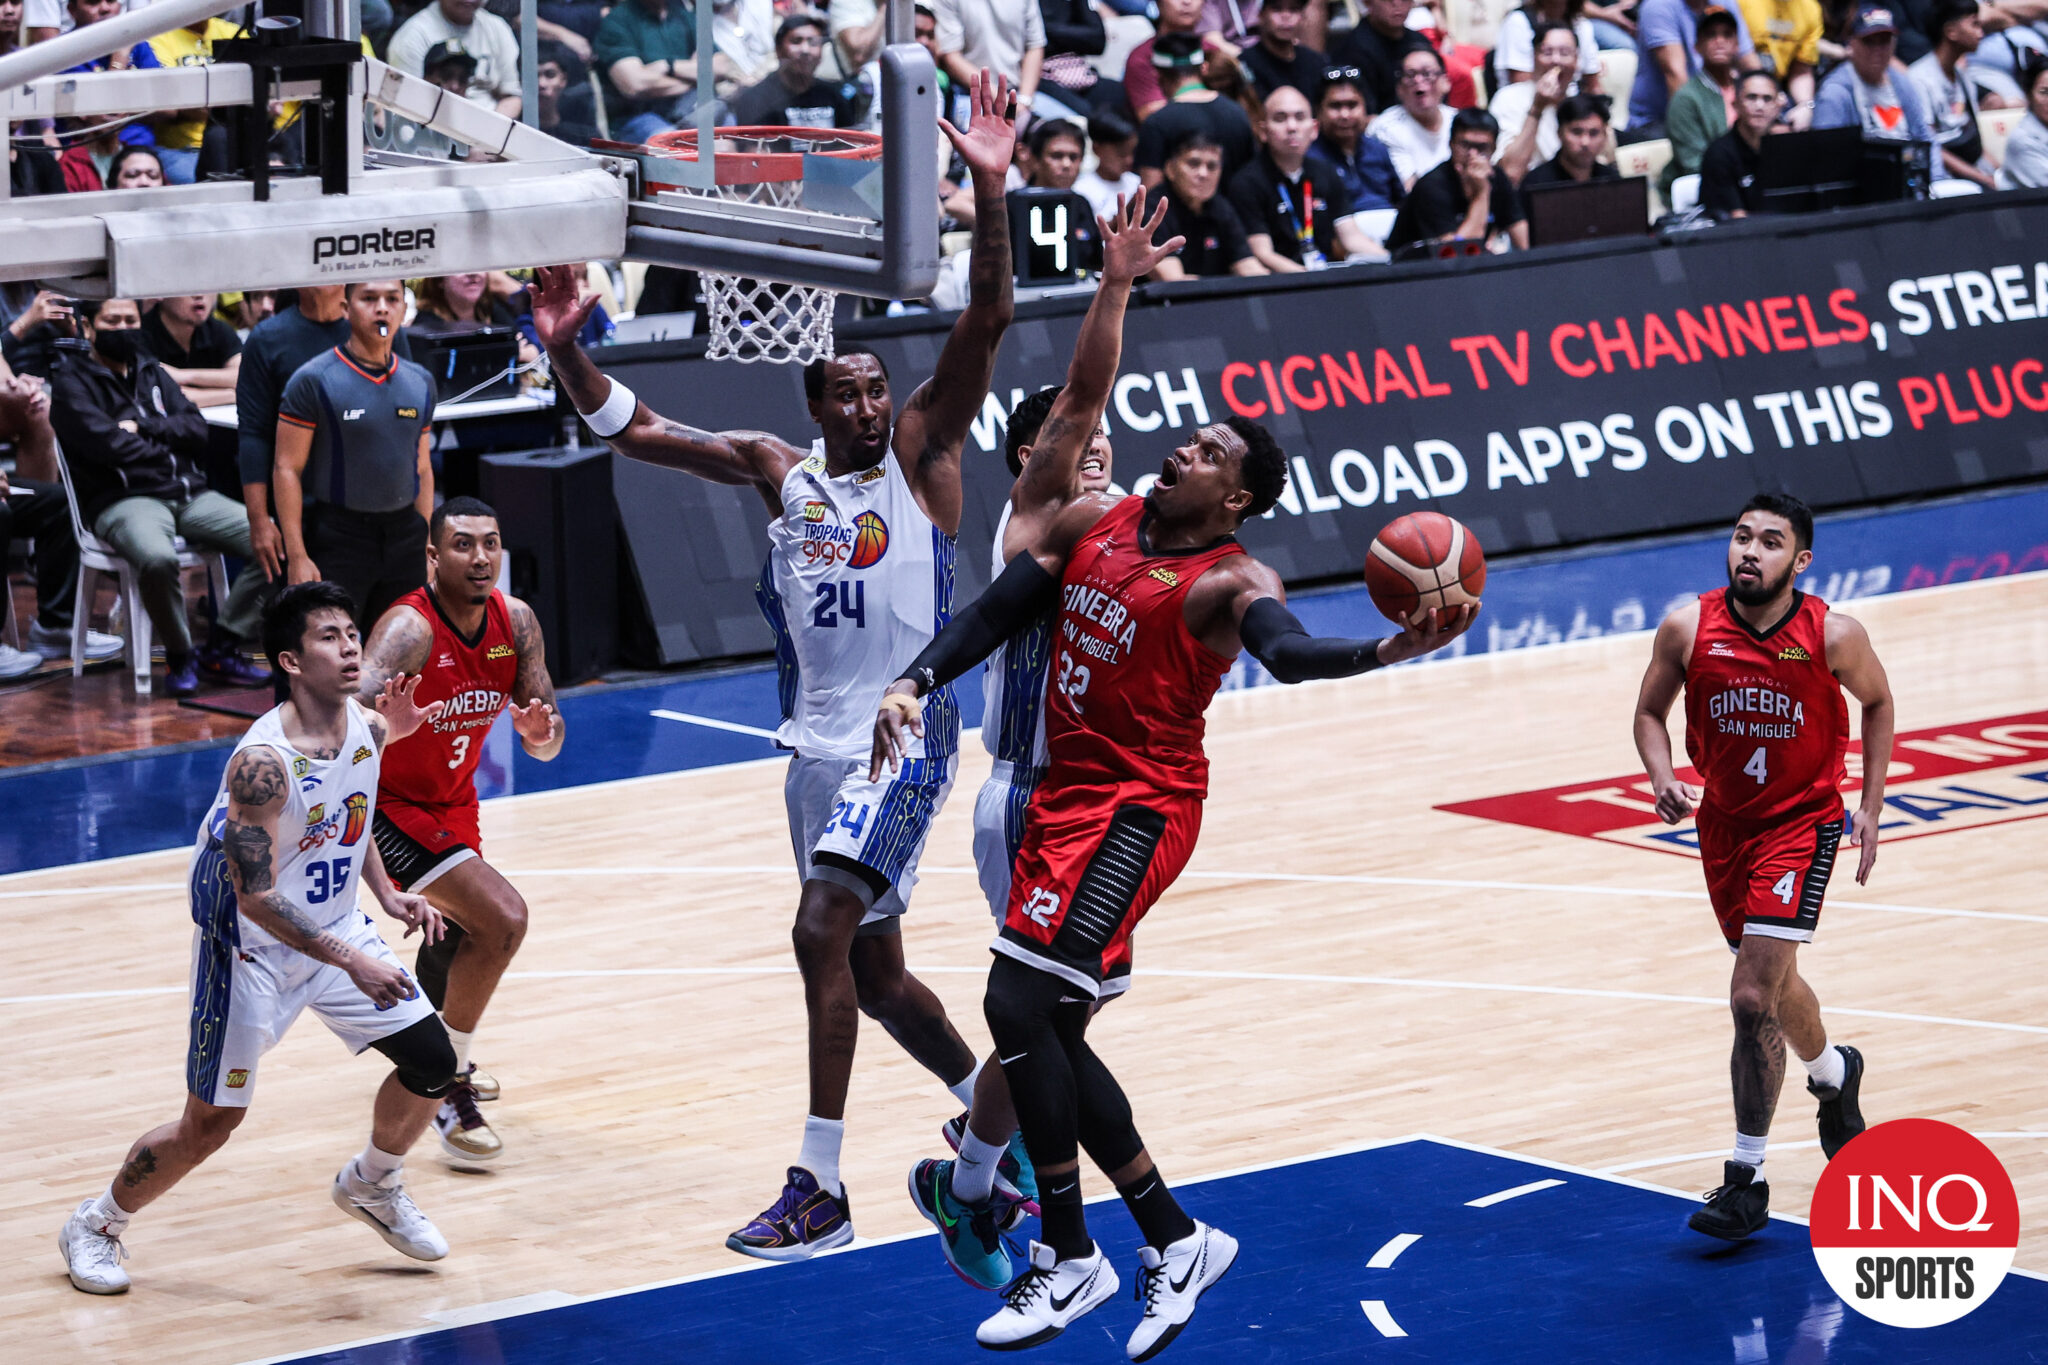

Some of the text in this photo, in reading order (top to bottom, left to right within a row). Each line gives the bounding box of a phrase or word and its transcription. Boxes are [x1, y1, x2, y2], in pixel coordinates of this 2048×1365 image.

[1030, 204, 1067, 271] 4
[969, 368, 1211, 451] WCH
[1220, 343, 1451, 418] CIGNAL
[1450, 330, 1529, 390] TV
[1550, 288, 1888, 379] CHANNELS,
[1487, 411, 1648, 490] APPS
[1655, 398, 1754, 464] ON
[1753, 381, 1893, 448] THIS
[805, 524, 852, 543] TROPANG
[814, 580, 865, 628] 24
[1062, 618, 1118, 665] AN MIGUEL
[1778, 652, 1811, 661] FINALS
[1057, 650, 1091, 715] 32
[1727, 676, 1790, 690] BARANGAY
[1709, 687, 1804, 727] GINEBRA
[433, 720, 458, 734] SAN
[1718, 719, 1797, 739] SAN MIGUEL
[448, 735, 471, 770] 3
[1742, 746, 1767, 784] 4
[824, 801, 871, 839] 24
[306, 856, 352, 904] 35
[1771, 870, 1797, 905] 4
[1022, 886, 1061, 928] 32
[226, 1071, 250, 1087] TNT
